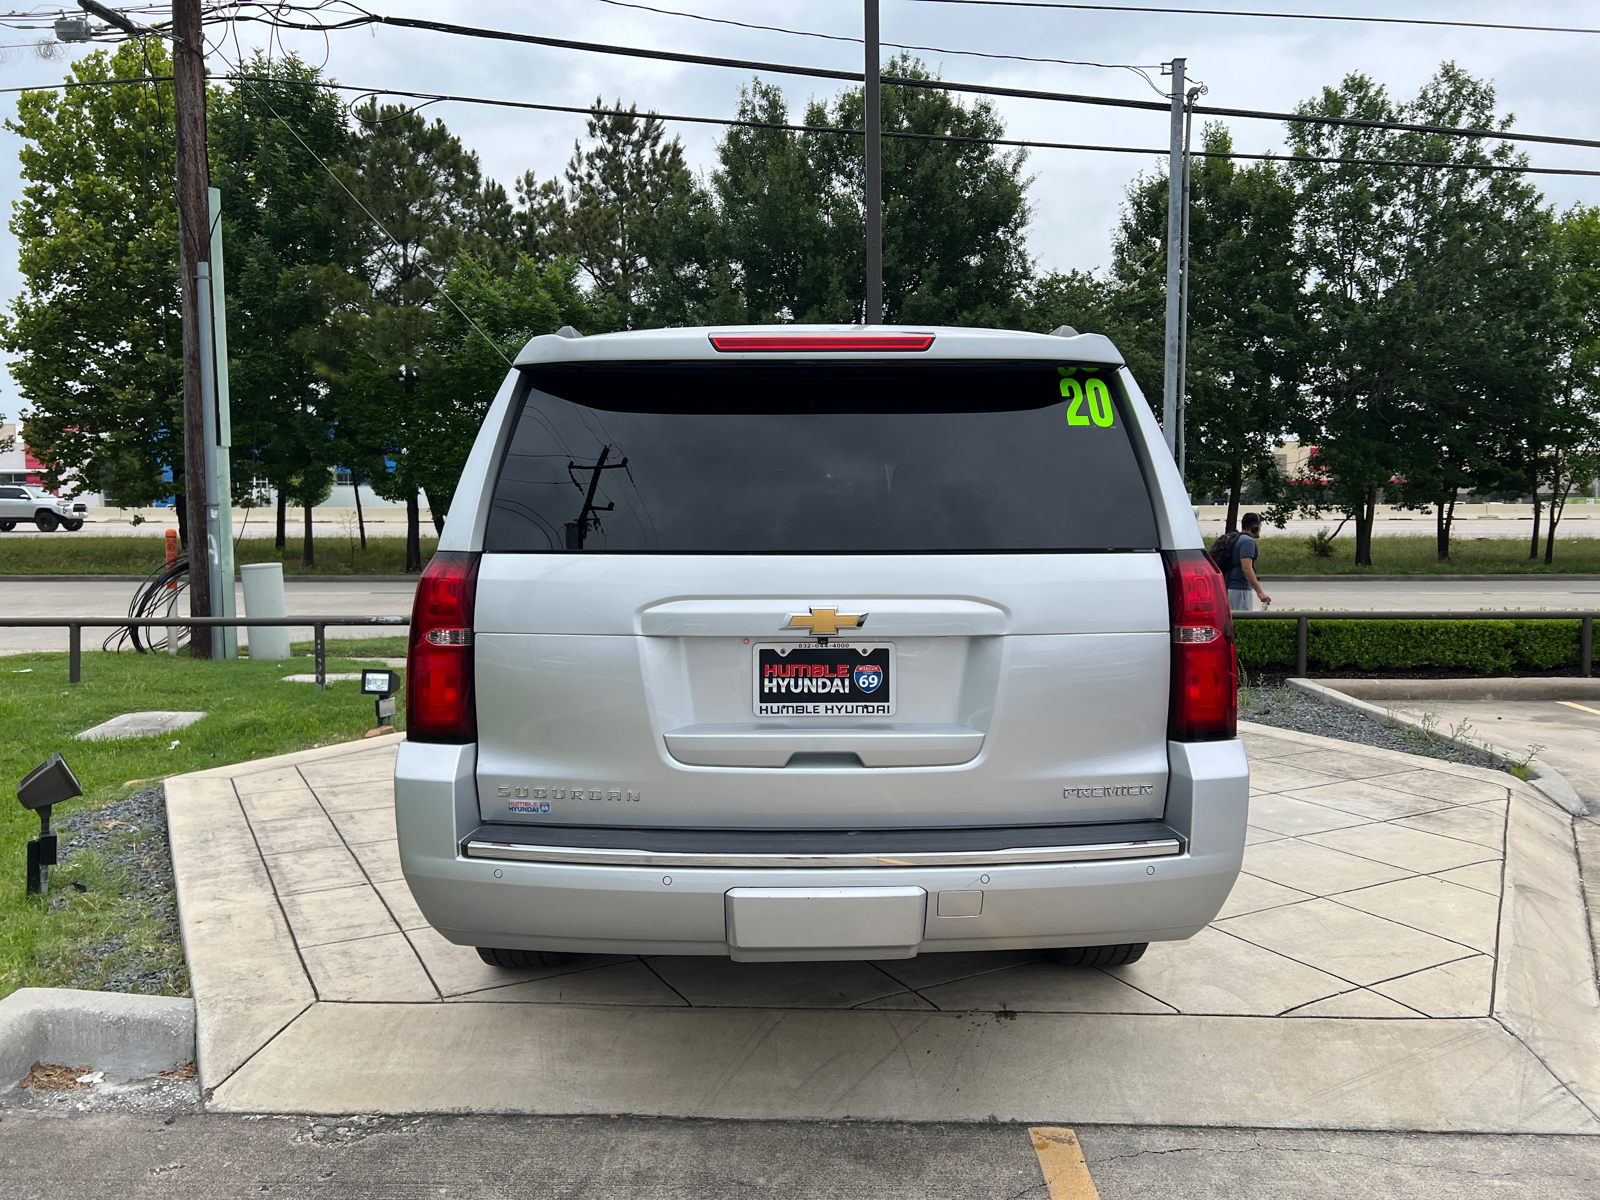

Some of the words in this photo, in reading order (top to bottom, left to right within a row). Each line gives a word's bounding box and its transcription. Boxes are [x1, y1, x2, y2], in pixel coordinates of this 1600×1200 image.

[1060, 377, 1114, 428] 20
[764, 664, 850, 677] HUMBLE
[763, 677, 850, 693] HYUNDAI
[858, 674, 879, 688] 69
[759, 705, 820, 715] HUMBLE
[825, 705, 890, 714] HYUNDAI
[498, 786, 641, 802] SUBURBAN
[1063, 784, 1154, 799] PREMIER
